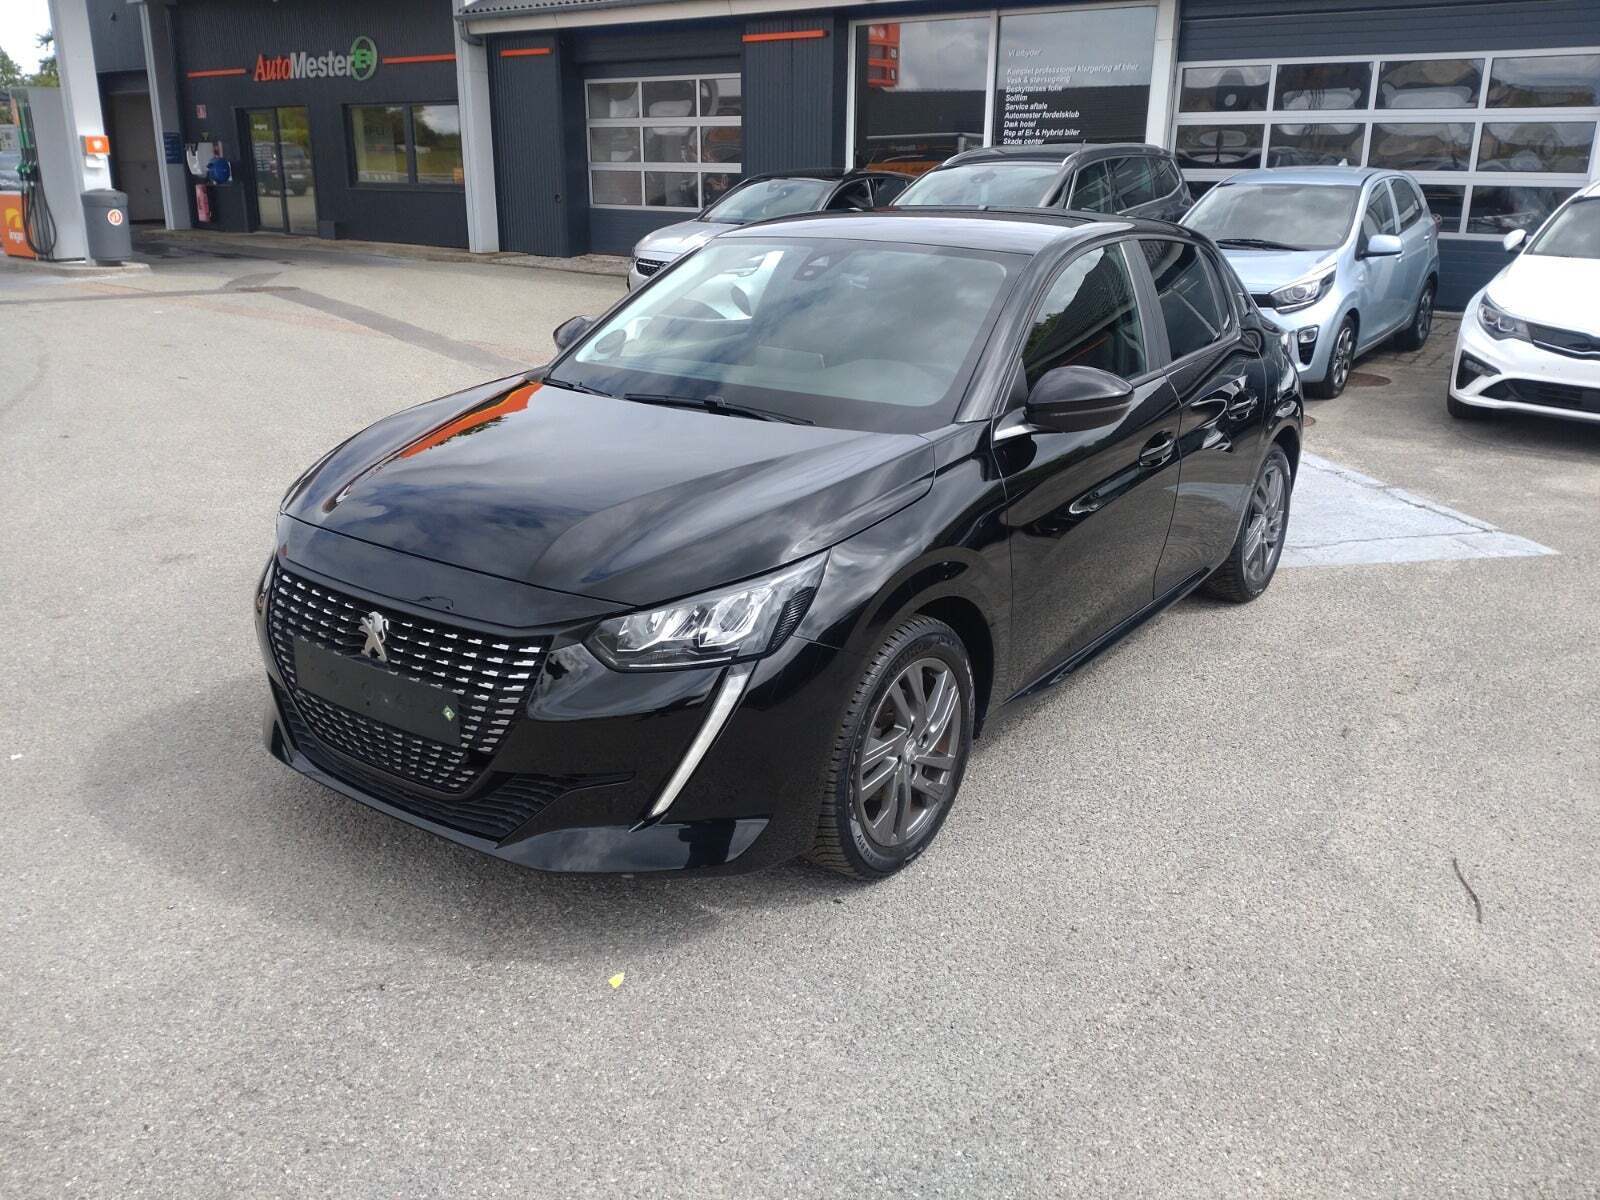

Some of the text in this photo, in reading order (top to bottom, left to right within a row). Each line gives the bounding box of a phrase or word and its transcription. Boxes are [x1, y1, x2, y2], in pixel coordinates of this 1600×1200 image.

[254, 50, 354, 81] AutoMester
[1005, 102, 1029, 111] Service
[1003, 128, 1016, 137] Rep
[1041, 127, 1064, 137] Hybrid
[1064, 127, 1081, 136] biler
